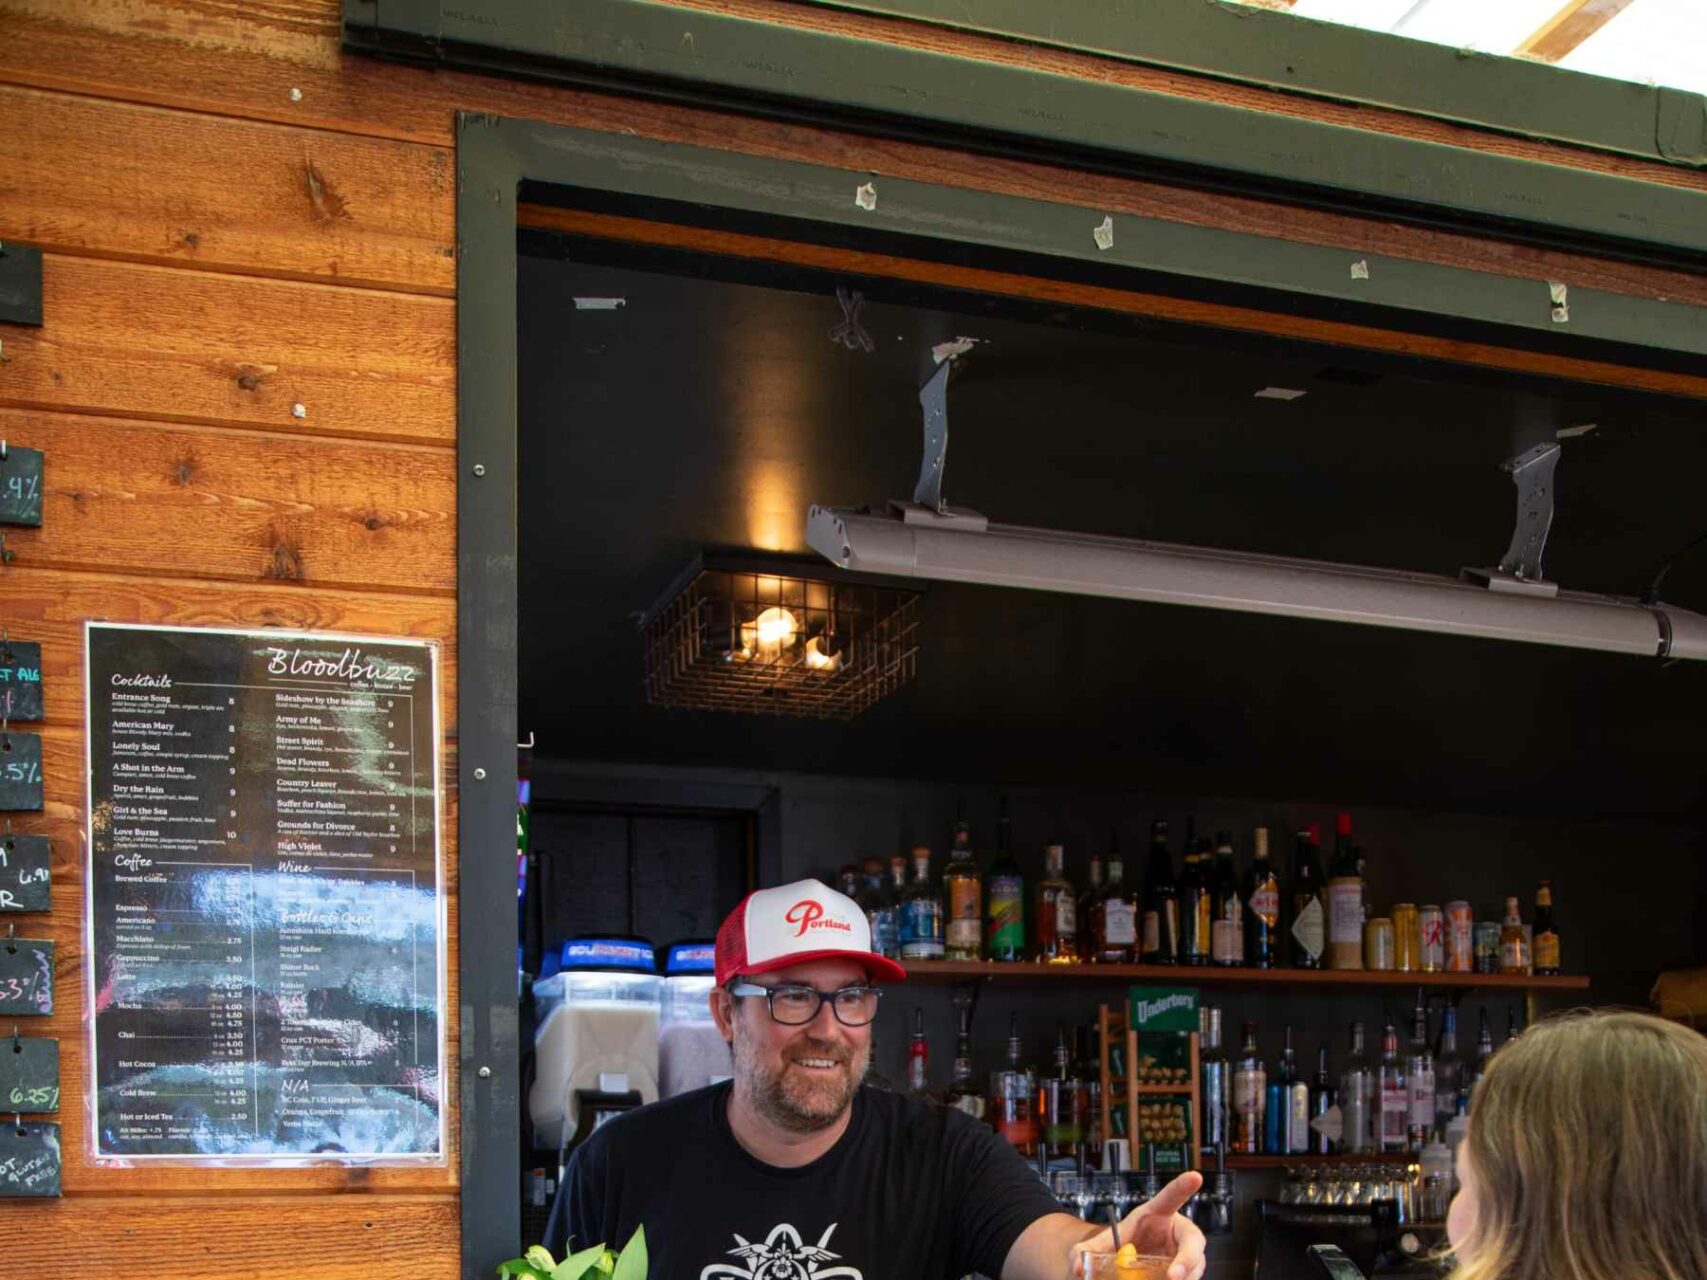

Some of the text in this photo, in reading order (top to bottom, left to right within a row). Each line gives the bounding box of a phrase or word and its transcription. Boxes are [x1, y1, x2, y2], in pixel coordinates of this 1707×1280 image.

[266, 646, 415, 682] Bloodbuzz
[111, 673, 172, 688] Cocktails
[112, 692, 149, 702] Entrance
[150, 694, 171, 704] Song
[275, 693, 314, 704] Sideshow
[315, 696, 325, 706] by
[326, 696, 340, 705] the
[276, 715, 298, 725] Army
[299, 715, 308, 724] of
[309, 716, 321, 725] Me
[112, 720, 152, 730] American
[153, 722, 174, 732] Mary
[113, 741, 140, 752] Lonely
[141, 743, 160, 752] Soul
[276, 736, 300, 746] Street
[301, 738, 323, 748] Spirit
[276, 757, 297, 766] Dead
[298, 758, 330, 767] Flowers
[112, 763, 236, 776] A Shot in the Arm 9
[276, 778, 310, 788] Country
[311, 779, 337, 789] Leaver
[113, 784, 236, 796] Dry the Rain 9
[276, 799, 304, 809] Suffer
[305, 800, 314, 809] for
[315, 801, 346, 810] Fashion
[113, 806, 130, 815] Girl
[138, 807, 152, 815] the
[153, 808, 168, 816] Sea
[277, 820, 312, 830] Grounds
[312, 821, 324, 830] for
[325, 822, 356, 832] Divorce
[113, 828, 133, 836] Love
[134, 828, 159, 837] Burns
[227, 831, 237, 839] 10
[277, 841, 297, 852] High
[298, 842, 323, 851] Violet
[114, 853, 153, 872] Coffee
[278, 860, 312, 873] Wine
[115, 874, 168, 883] Brewed Coffee
[115, 904, 148, 913] Espresso
[115, 917, 156, 925] Americano
[785, 899, 851, 937] Portland
[116, 935, 155, 943] Macchiato
[115, 954, 160, 963] Cappuccino
[117, 973, 137, 981] Latte
[118, 1002, 242, 1011] Mocha 4.00
[226, 1011, 243, 1019] 4.50
[227, 1020, 243, 1028] 4.75
[118, 1031, 243, 1040] Chai 3.50
[313, 1037, 335, 1045] Porter
[226, 1040, 244, 1048] 4.00
[119, 1060, 156, 1068] Hot Cocoa
[281, 1079, 310, 1093] N/A
[10, 1086, 60, 1110] 6.25%
[119, 1089, 137, 1097] Cold
[229, 1090, 247, 1098] 4.00
[119, 1113, 134, 1121] Hot
[144, 1113, 160, 1121] Iced
